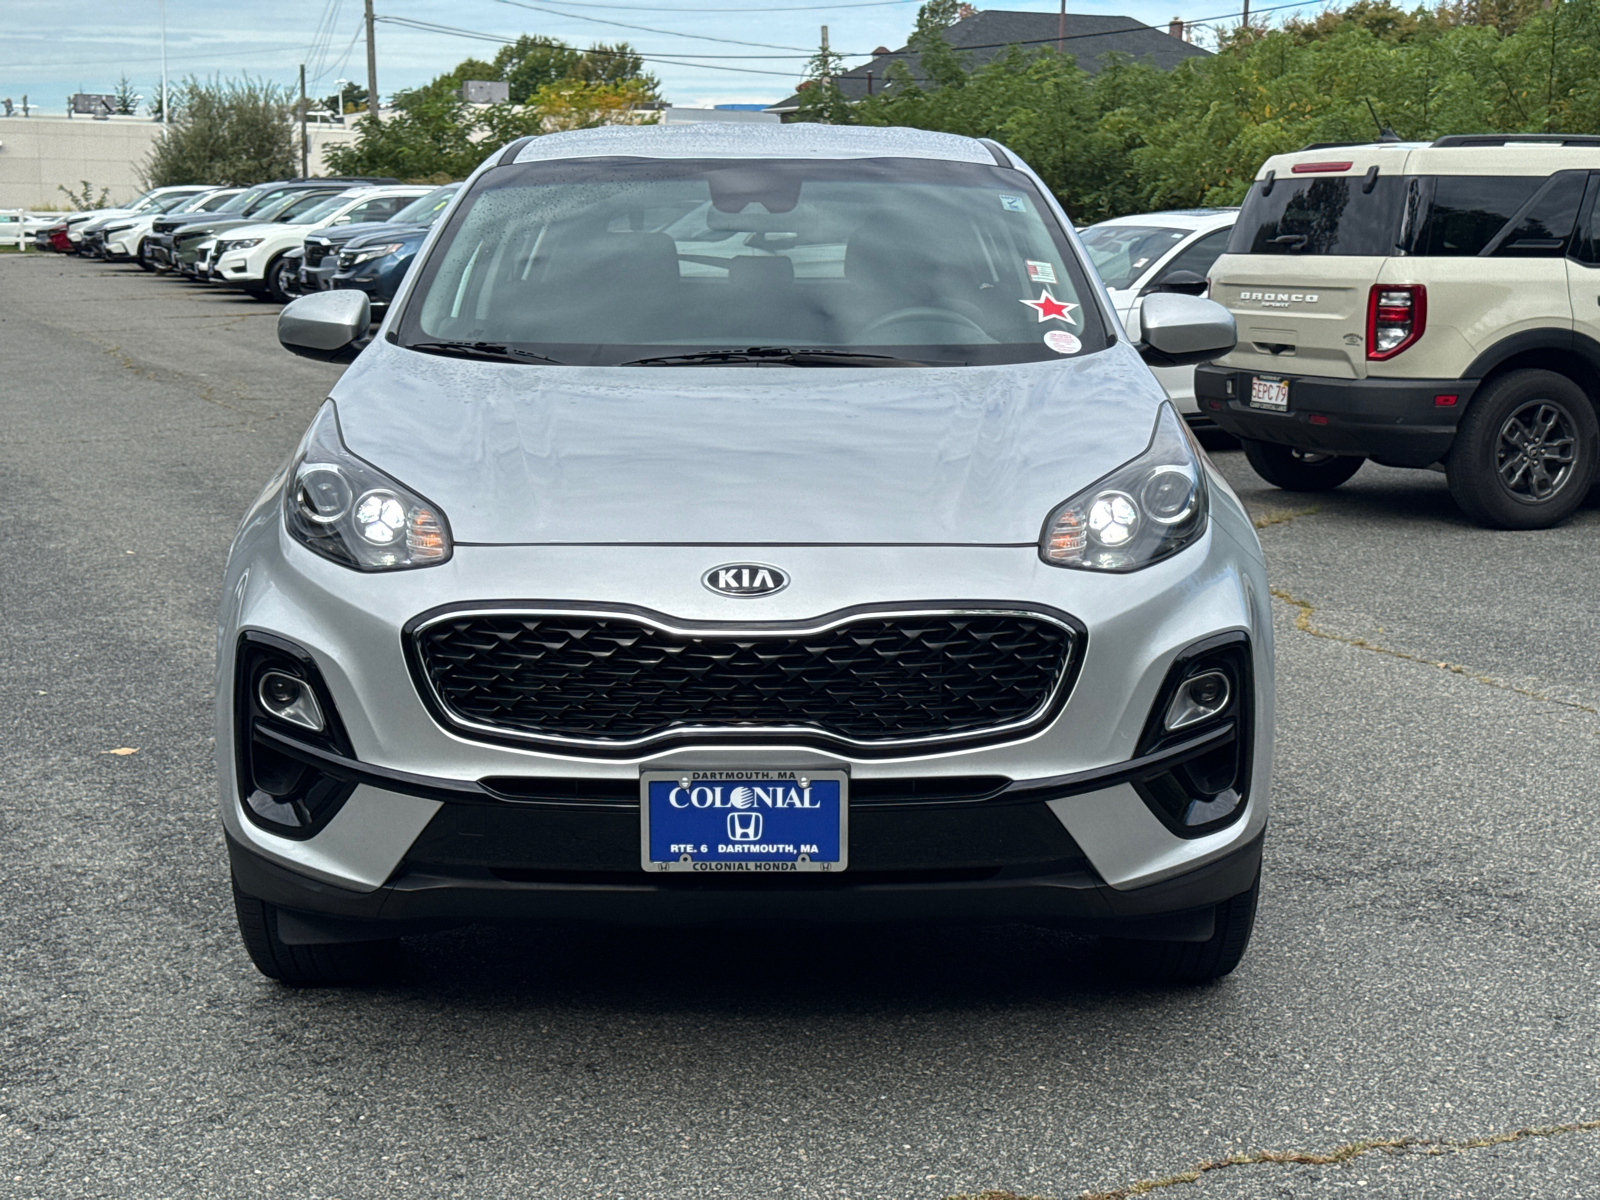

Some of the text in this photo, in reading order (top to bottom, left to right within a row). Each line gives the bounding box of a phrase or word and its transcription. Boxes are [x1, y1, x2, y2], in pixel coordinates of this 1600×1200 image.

[1240, 291, 1319, 303] BRONCO
[718, 568, 775, 588] KIA
[692, 771, 796, 780] DARTMOUTH, MA
[669, 786, 821, 809] COLONIAL
[670, 844, 819, 854] RTE. 6 DARTMOUTH, MA
[692, 862, 798, 871] COLONIAL HONDA
